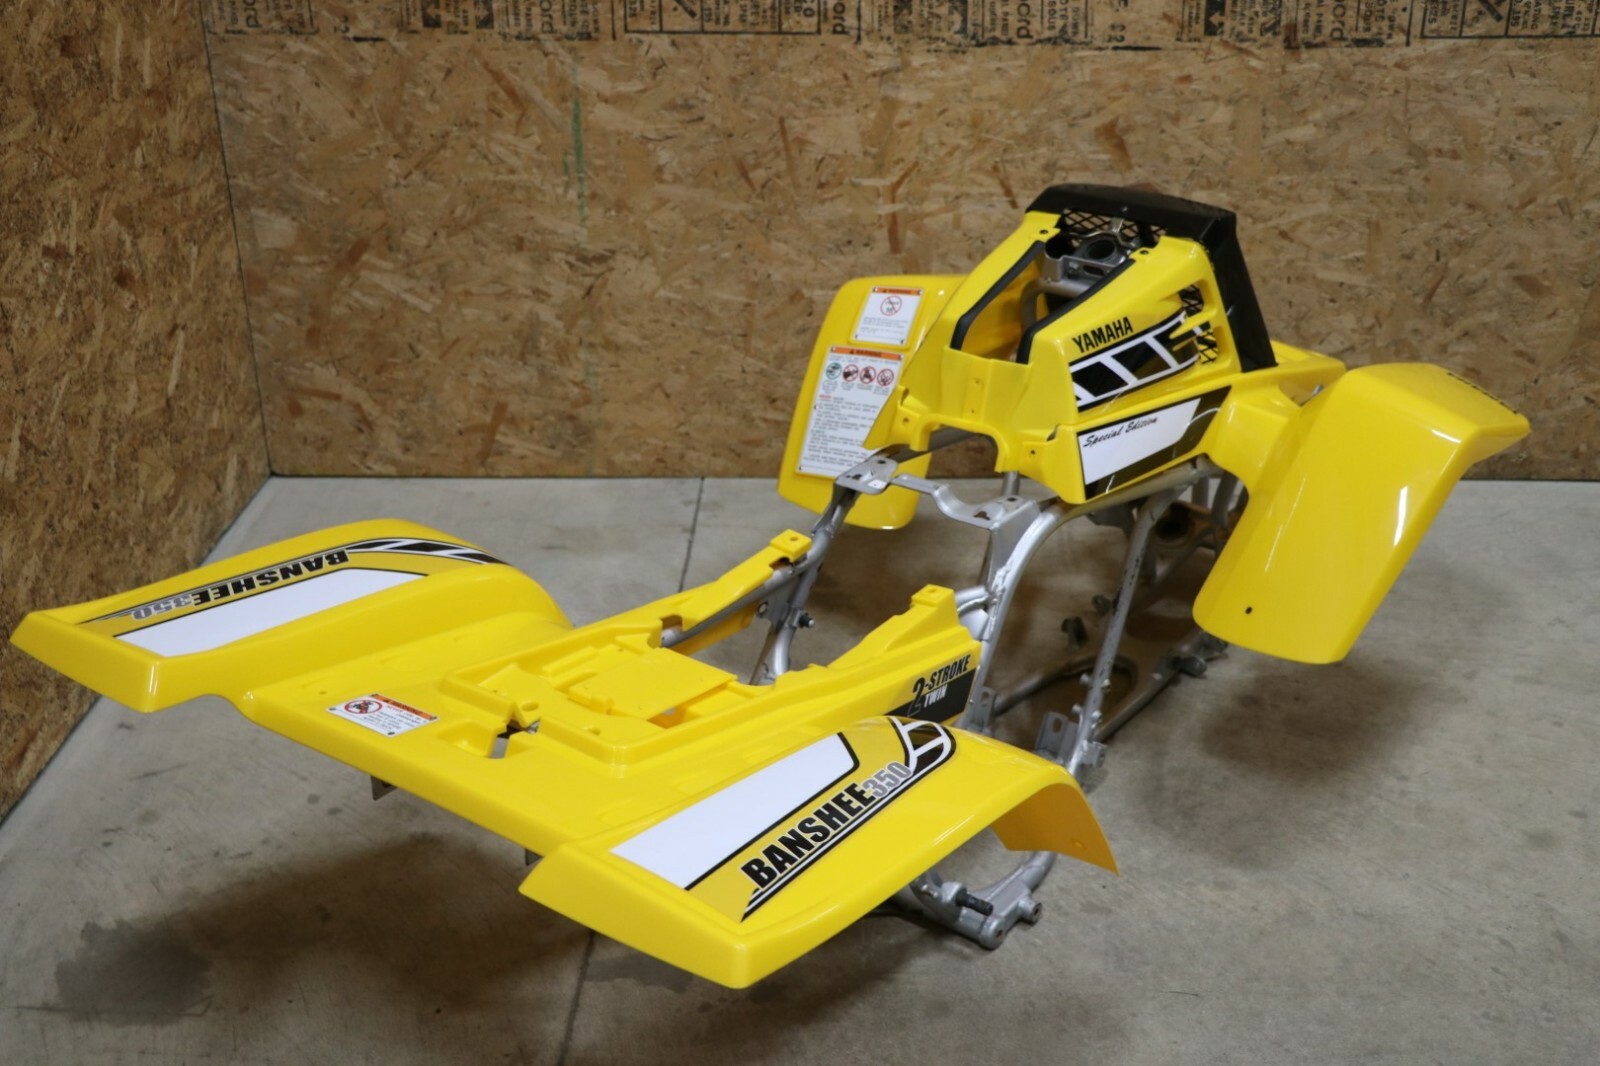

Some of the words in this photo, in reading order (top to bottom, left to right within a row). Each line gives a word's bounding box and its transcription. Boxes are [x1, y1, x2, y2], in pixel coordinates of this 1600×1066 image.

[1072, 316, 1134, 353] YAMAHA
[1083, 425, 1124, 447] Special
[1125, 417, 1158, 433] Edition
